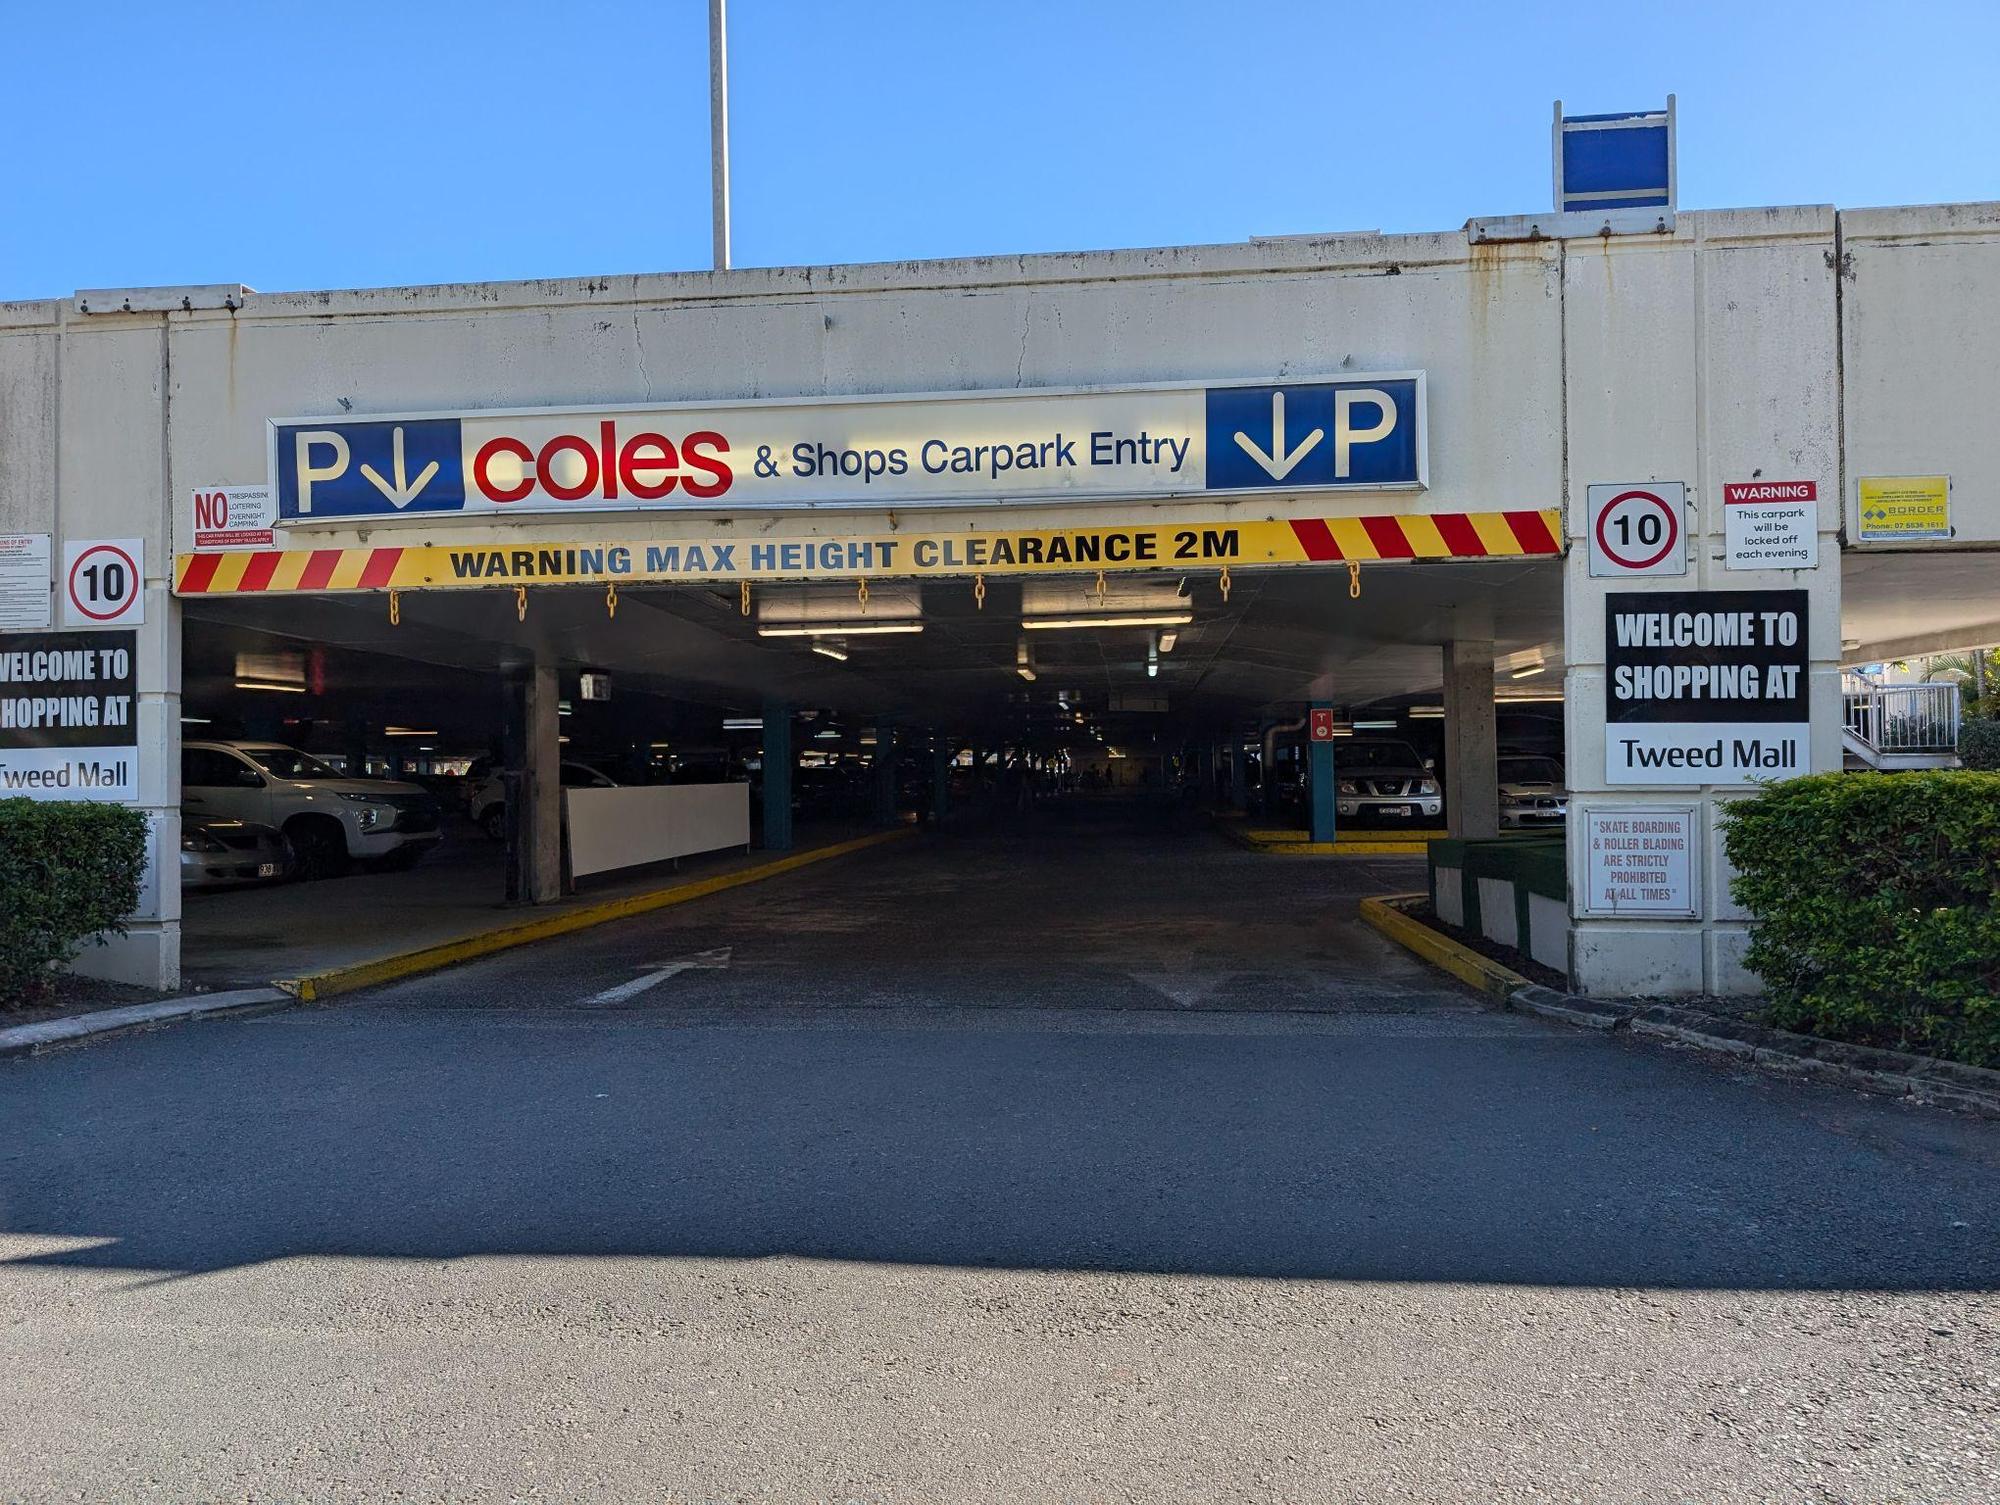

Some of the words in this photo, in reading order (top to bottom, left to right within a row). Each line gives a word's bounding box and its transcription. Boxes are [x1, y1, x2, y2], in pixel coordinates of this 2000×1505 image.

[1334, 388, 1398, 478] P
[295, 430, 351, 513] P
[473, 419, 733, 503] coles
[753, 444, 781, 479] &
[791, 442, 909, 484] Shops
[921, 433, 1077, 479] Carpark
[1090, 431, 1191, 473] Entry
[1731, 484, 1808, 500] WARNING
[195, 492, 228, 530] NO
[1736, 510, 1759, 520] This
[1761, 508, 1805, 523] carpark
[1613, 513, 1662, 546] 10
[1744, 536, 1780, 546] locked
[1782, 535, 1798, 545] off
[1753, 523, 1774, 532] will
[1775, 522, 1789, 531] be
[450, 547, 631, 578] WARNING
[647, 544, 736, 573] MAX
[751, 541, 898, 571] HEIGHT
[913, 533, 1157, 567] CLEARANCE
[1173, 529, 1240, 559] 2M
[1735, 549, 1762, 560] each
[1764, 549, 1809, 560] evening
[83, 563, 124, 601] 10
[1615, 612, 1755, 648] WELCOME
[1760, 611, 1798, 647] TO
[99, 648, 129, 680] TO
[1614, 664, 1759, 700] SHOPPING
[1765, 664, 1800, 699] AT
[0, 696, 99, 729] HOPPING
[103, 695, 130, 726] AT
[1619, 739, 1723, 768] Tweed
[1733, 739, 1796, 768] Mall
[78, 760, 127, 787] Mall
[1632, 820, 1681, 834] BOARDING
[1593, 837, 1601, 850] &
[1604, 838, 1639, 850] ROLLER
[1643, 838, 1684, 850] BLADING
[1603, 854, 1623, 867] ARE
[1625, 854, 1669, 867] STRICTLY
[1610, 871, 1667, 884] PROHIBITED
[1604, 888, 1617, 900] AT
[1620, 887, 1637, 900] ALL
